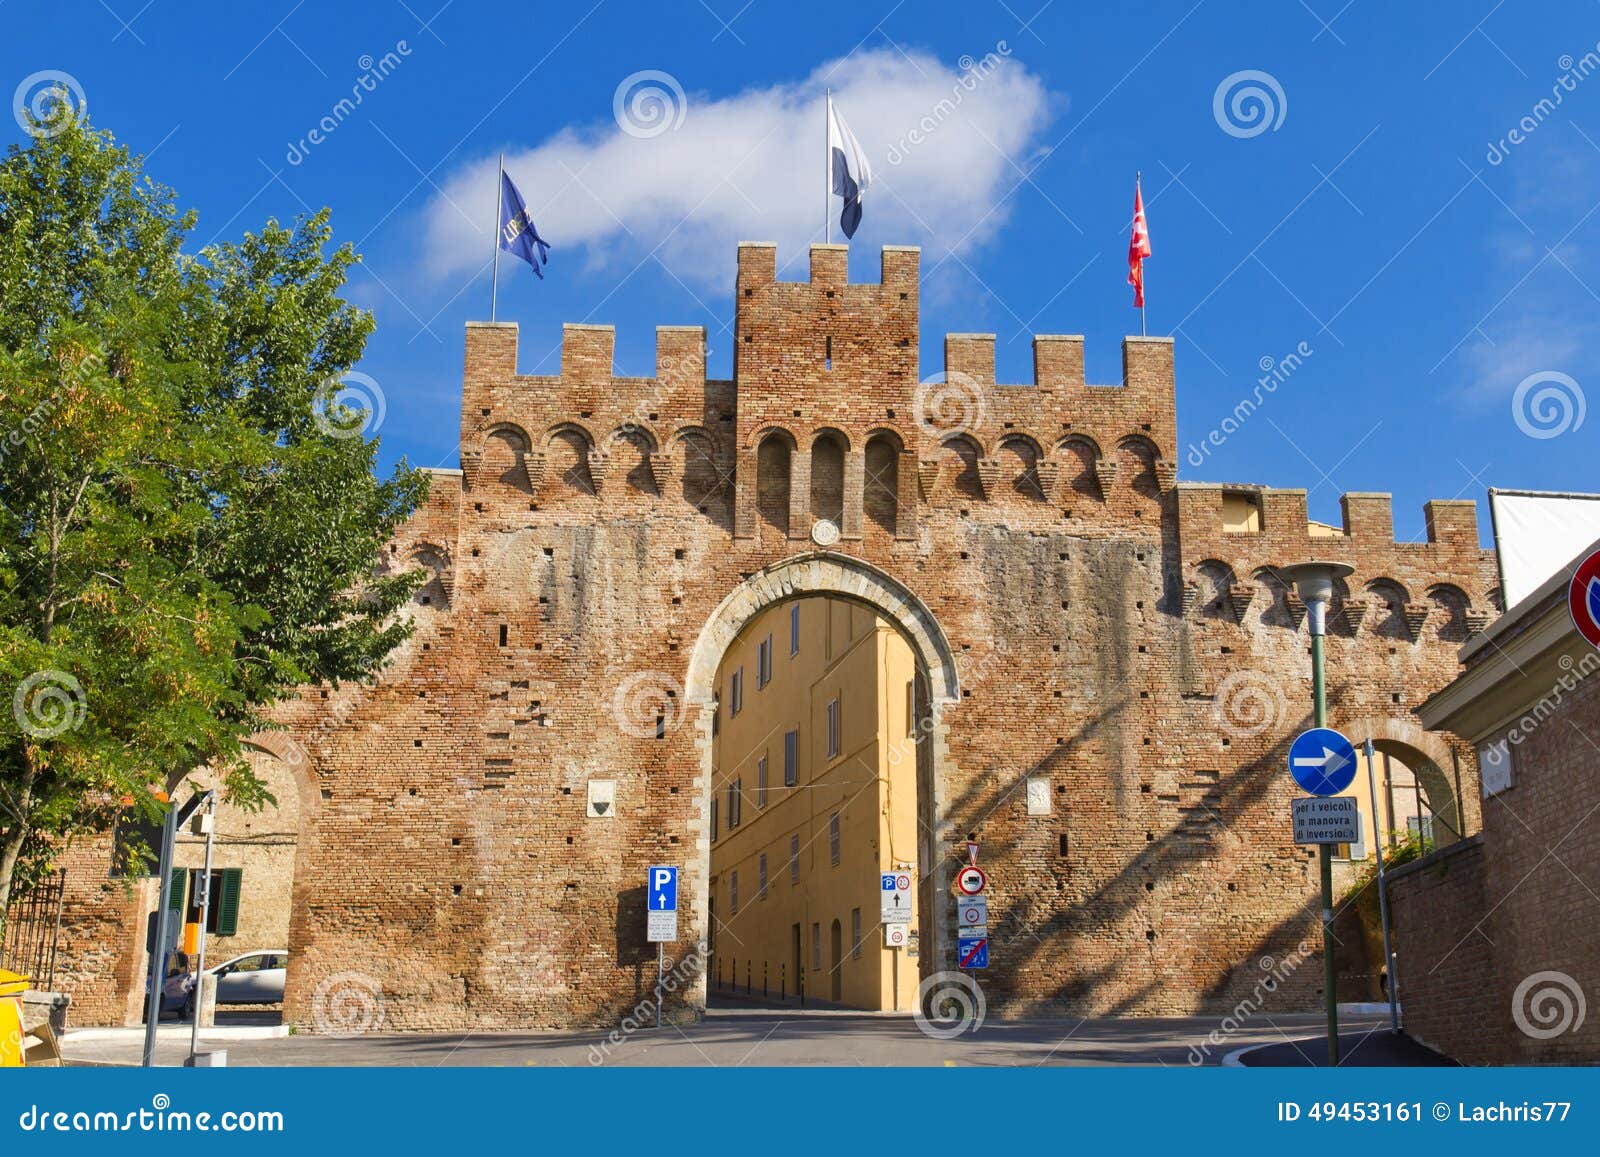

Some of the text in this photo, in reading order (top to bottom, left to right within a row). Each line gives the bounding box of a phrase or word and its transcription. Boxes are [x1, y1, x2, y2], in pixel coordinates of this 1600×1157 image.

[1296, 804, 1308, 815] per
[1318, 801, 1352, 812] veicoli
[1308, 816, 1350, 826] manovra
[655, 869, 672, 892] P
